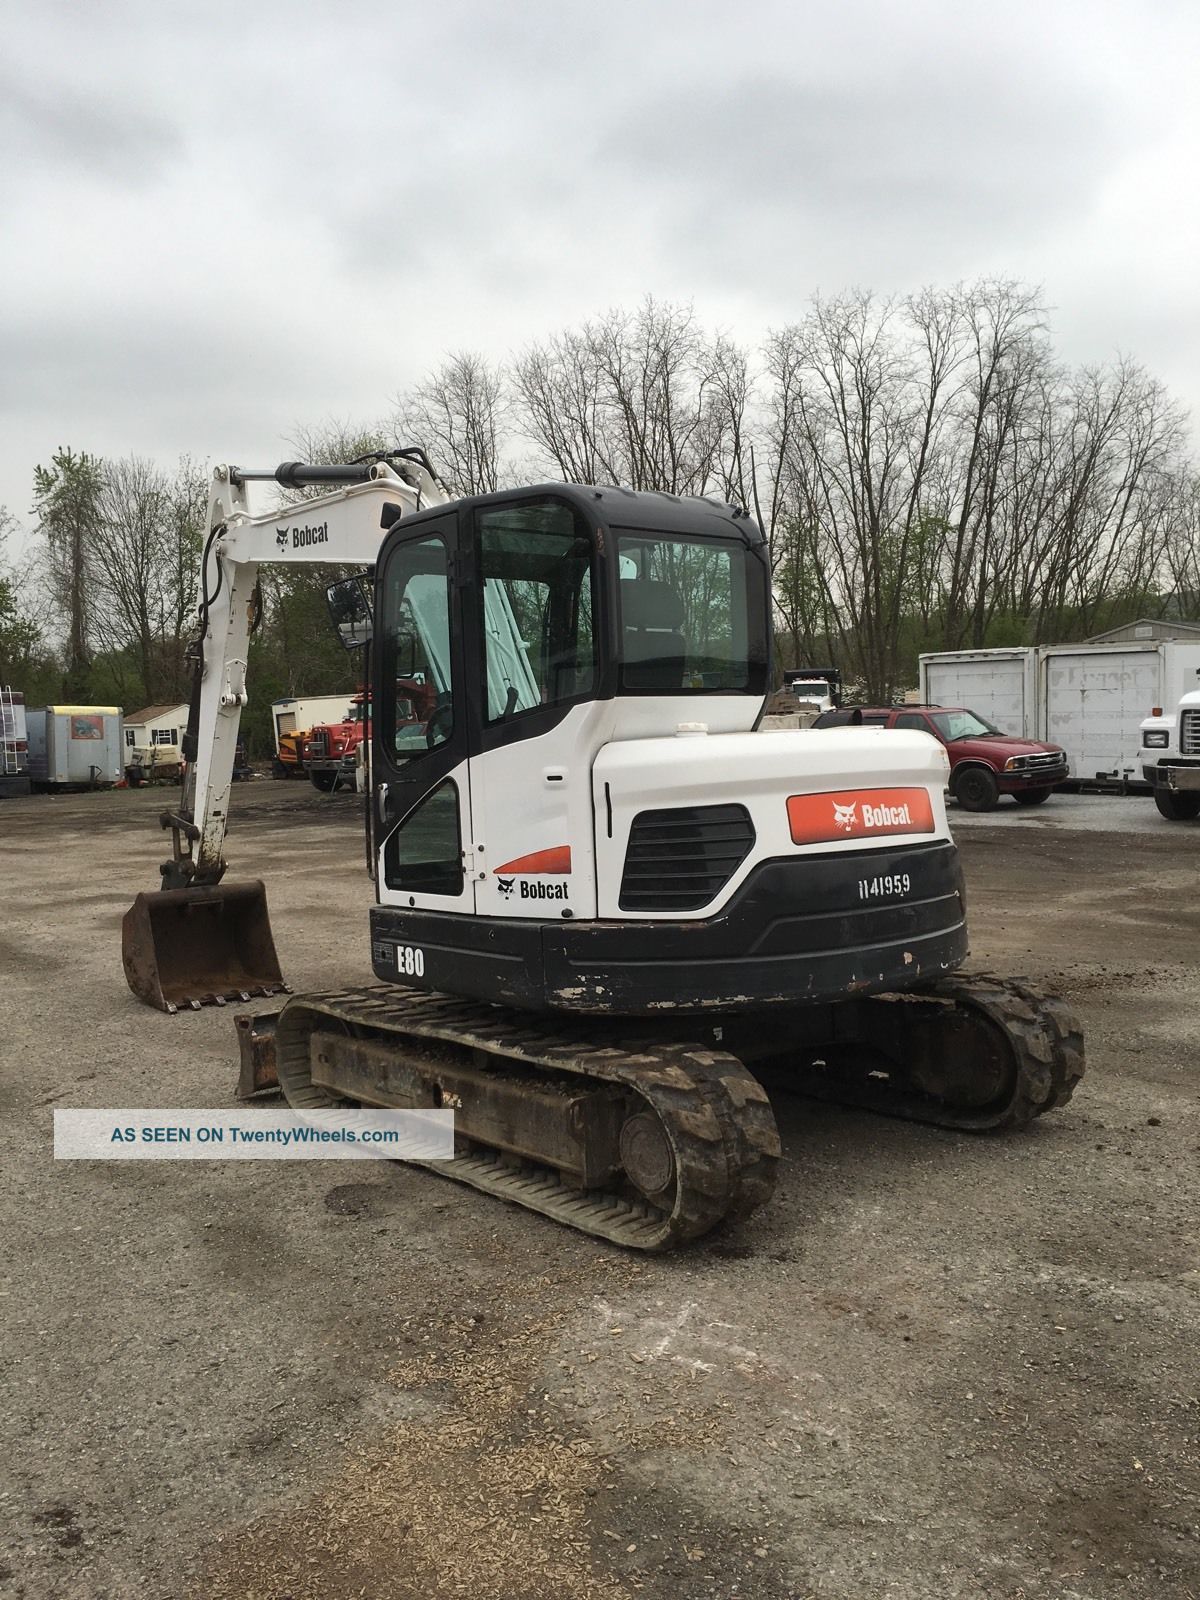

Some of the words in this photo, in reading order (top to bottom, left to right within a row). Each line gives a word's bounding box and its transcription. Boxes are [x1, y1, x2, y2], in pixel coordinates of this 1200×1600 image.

[292, 521, 329, 548] Bobcat
[861, 803, 911, 827] Bobcat
[520, 880, 569, 899] Bobcat
[397, 945, 425, 977] E80
